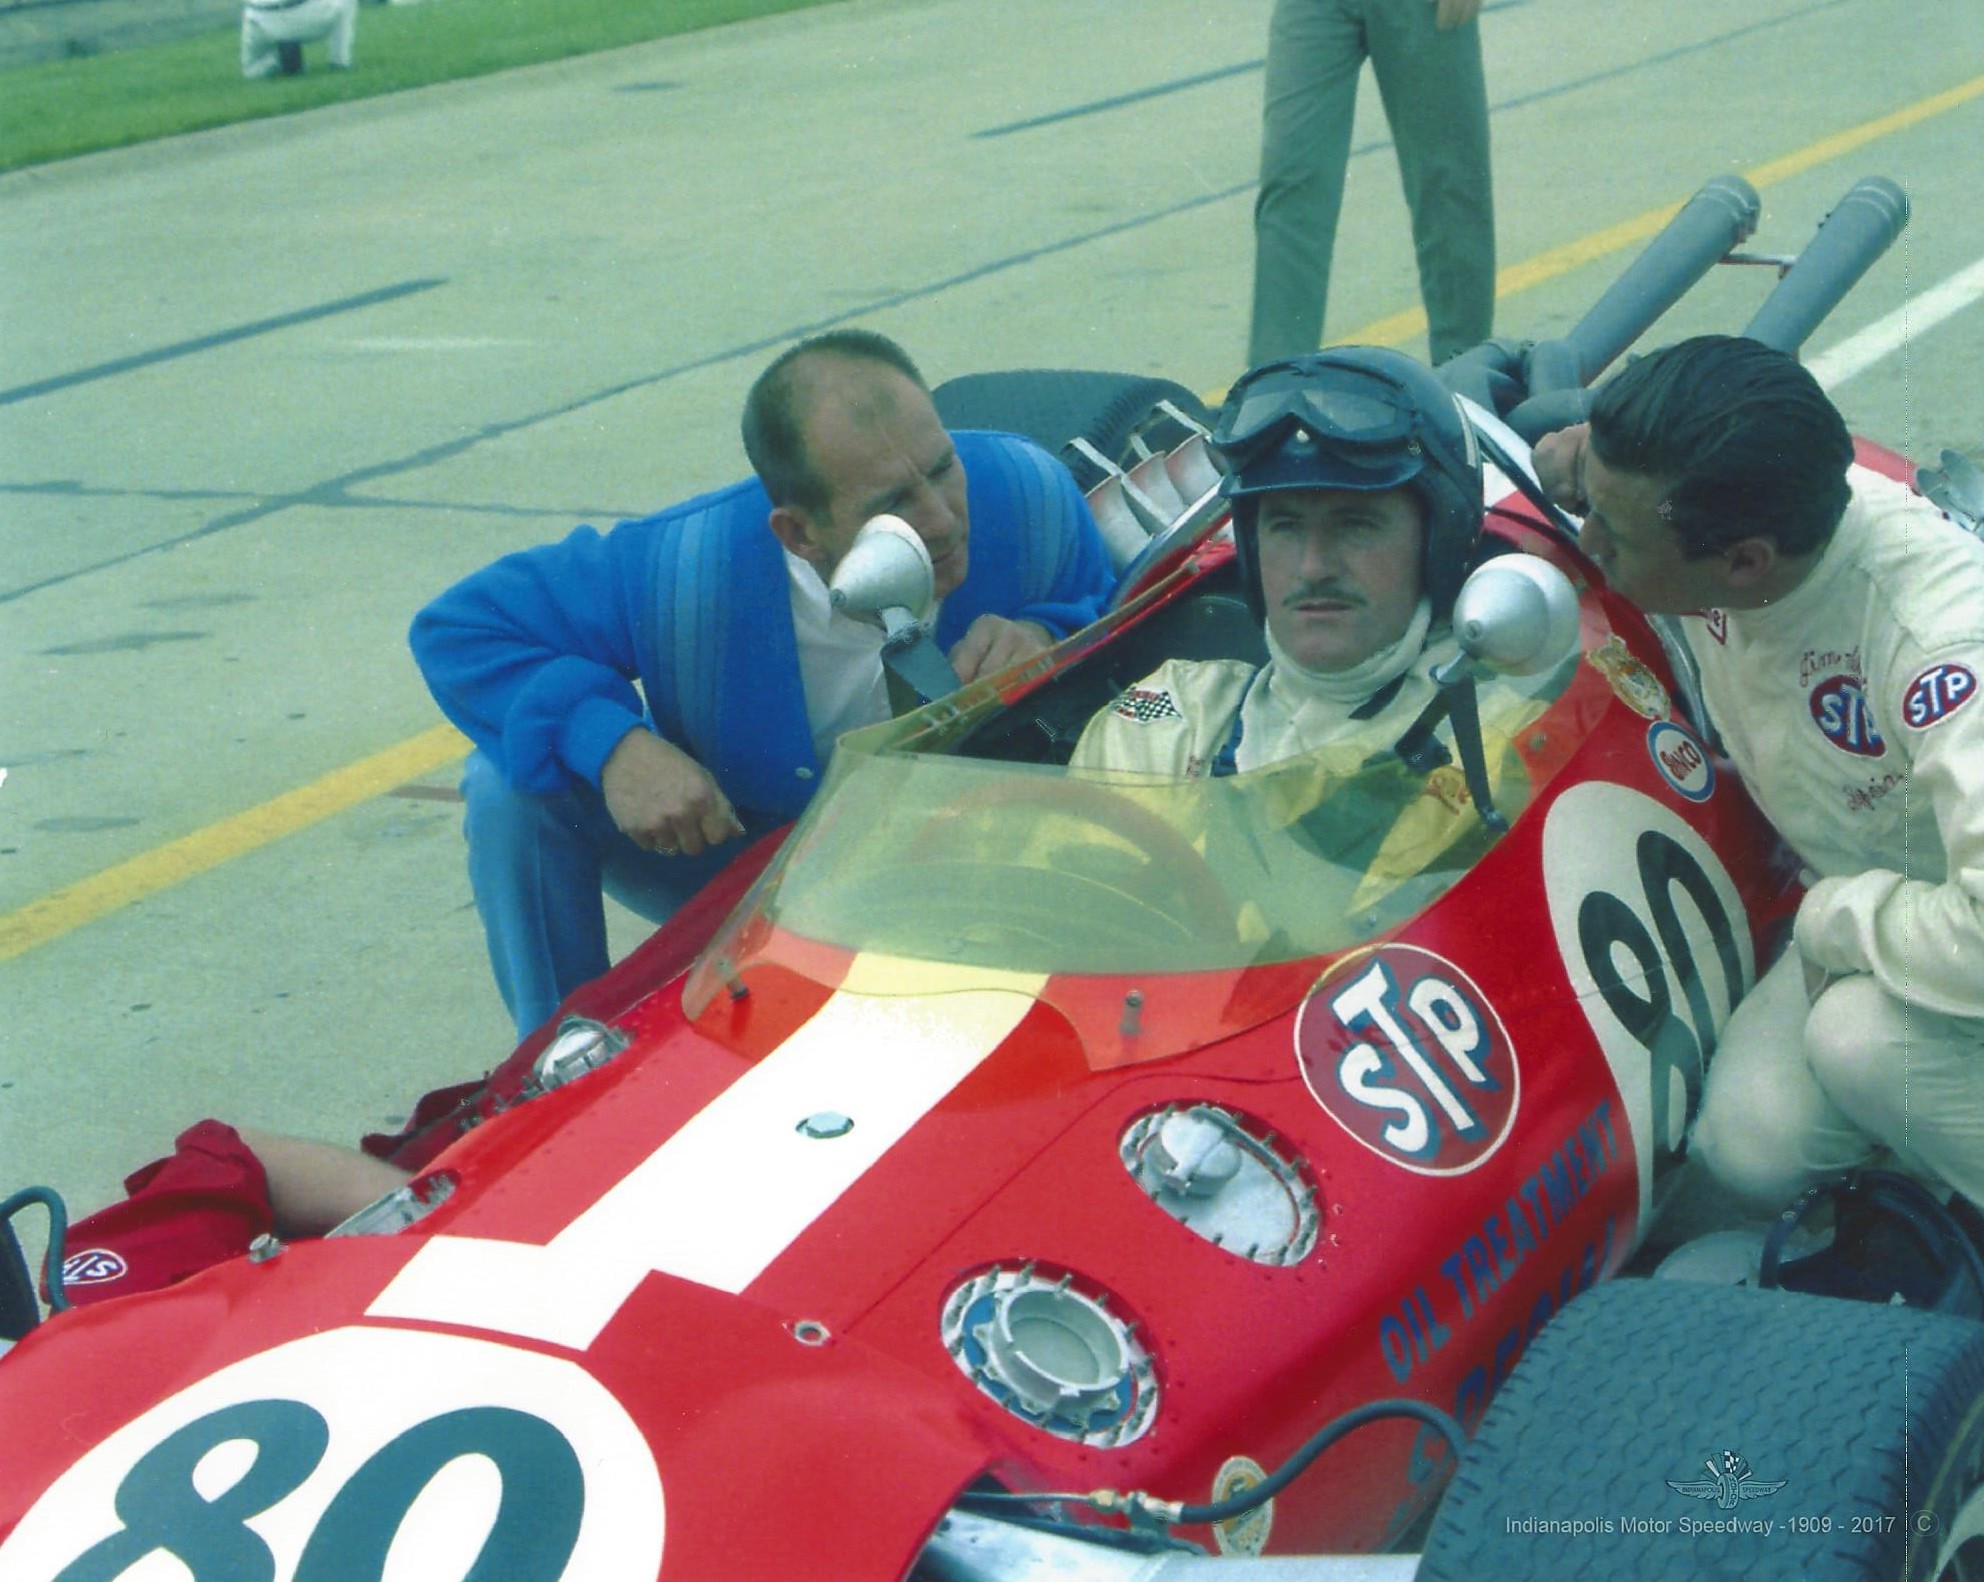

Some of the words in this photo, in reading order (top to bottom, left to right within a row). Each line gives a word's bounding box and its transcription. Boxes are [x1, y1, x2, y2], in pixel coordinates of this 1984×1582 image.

[1908, 667, 1970, 724] STP
[1328, 957, 1499, 1160] STP
[1577, 829, 1744, 1212] 80
[1379, 1284, 1452, 1384] OIL
[1440, 1100, 1619, 1322] TREATMENT
[49, 1397, 586, 1582] 80
